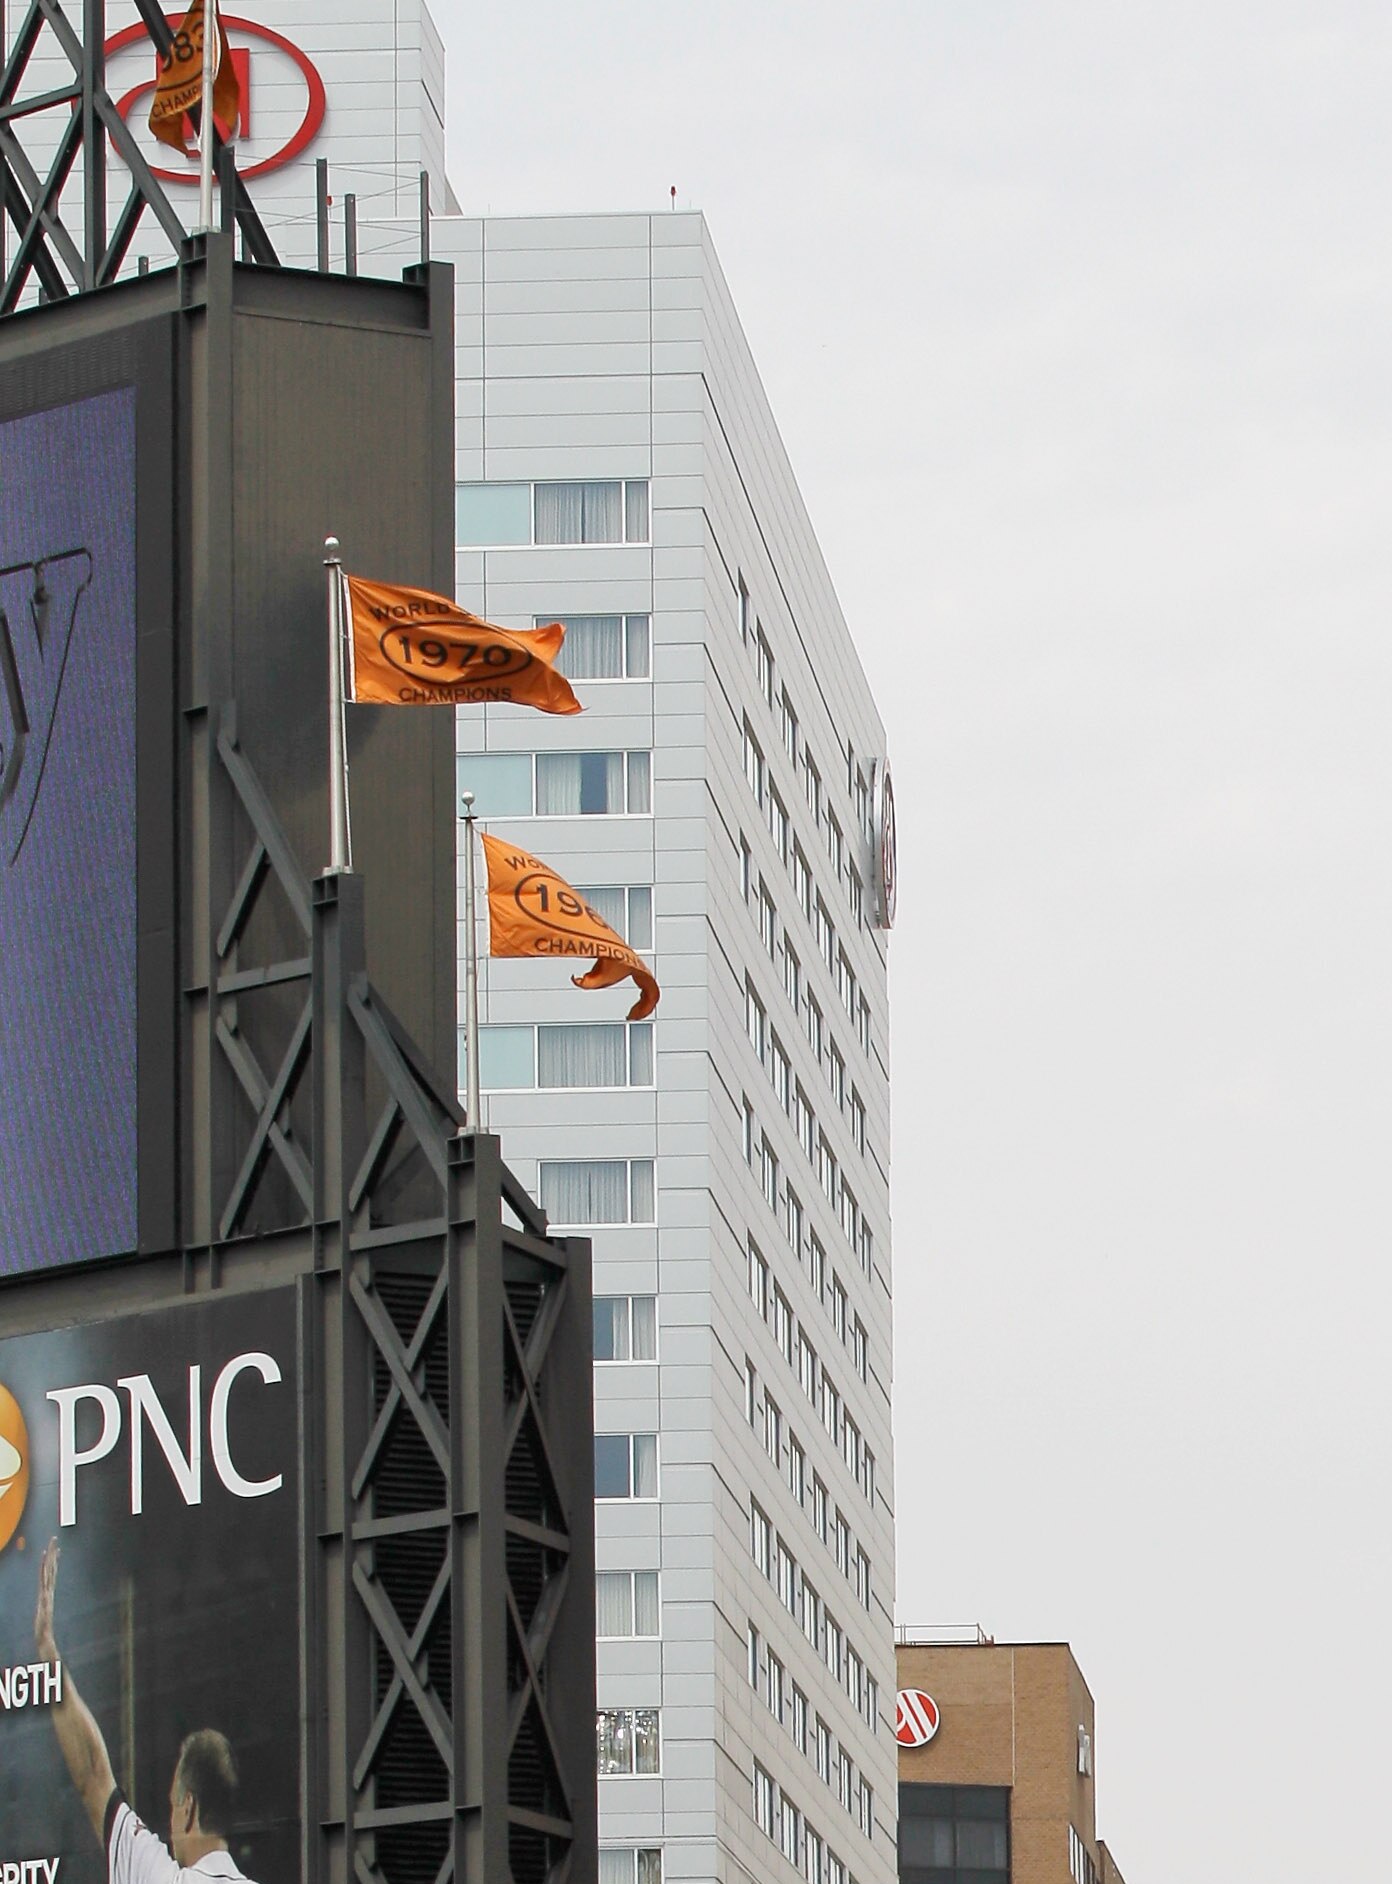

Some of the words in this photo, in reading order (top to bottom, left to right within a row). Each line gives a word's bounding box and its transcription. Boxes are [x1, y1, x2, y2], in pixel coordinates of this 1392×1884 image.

[399, 636, 512, 668] 1970
[400, 686, 512, 702] CHAMPIONS
[46, 1351, 284, 1528] PNC
